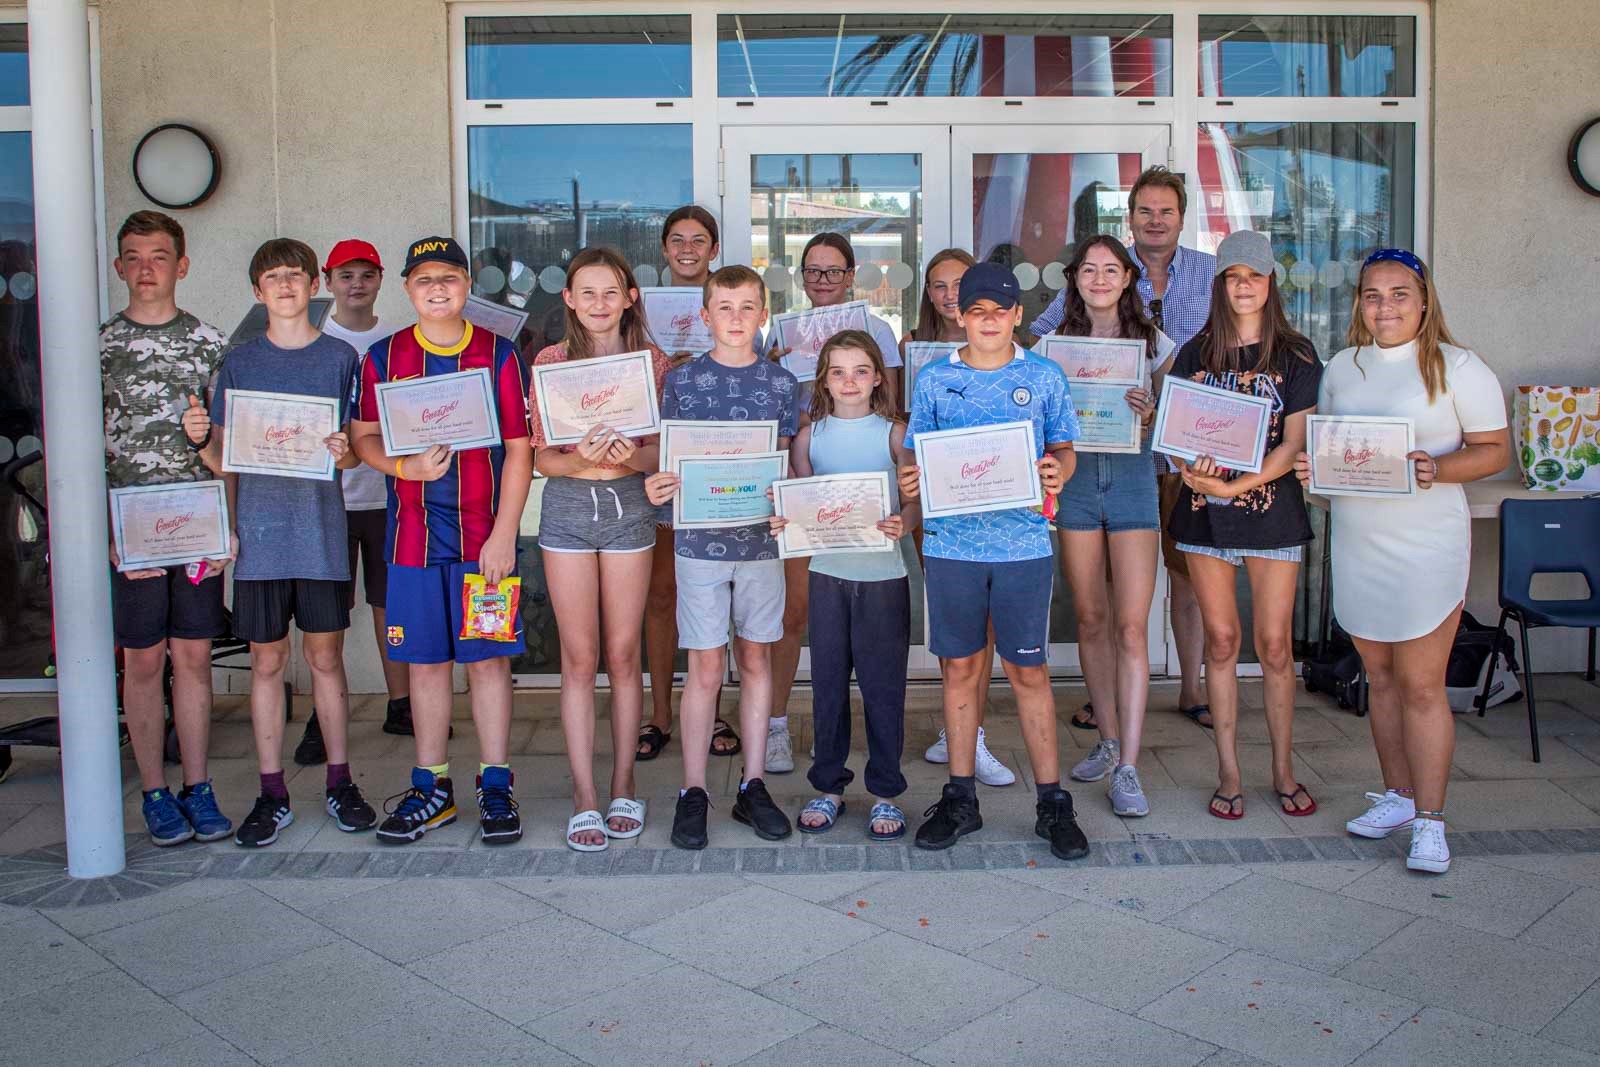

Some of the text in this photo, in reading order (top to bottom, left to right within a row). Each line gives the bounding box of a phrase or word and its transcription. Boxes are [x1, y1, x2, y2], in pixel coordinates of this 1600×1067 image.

[414, 241, 448, 257] NAVY
[422, 400, 459, 423] Great Job!
[1096, 410, 1113, 418] YOU!
[961, 455, 1000, 480] Great Job!
[710, 484, 757, 494] THANK YOU!
